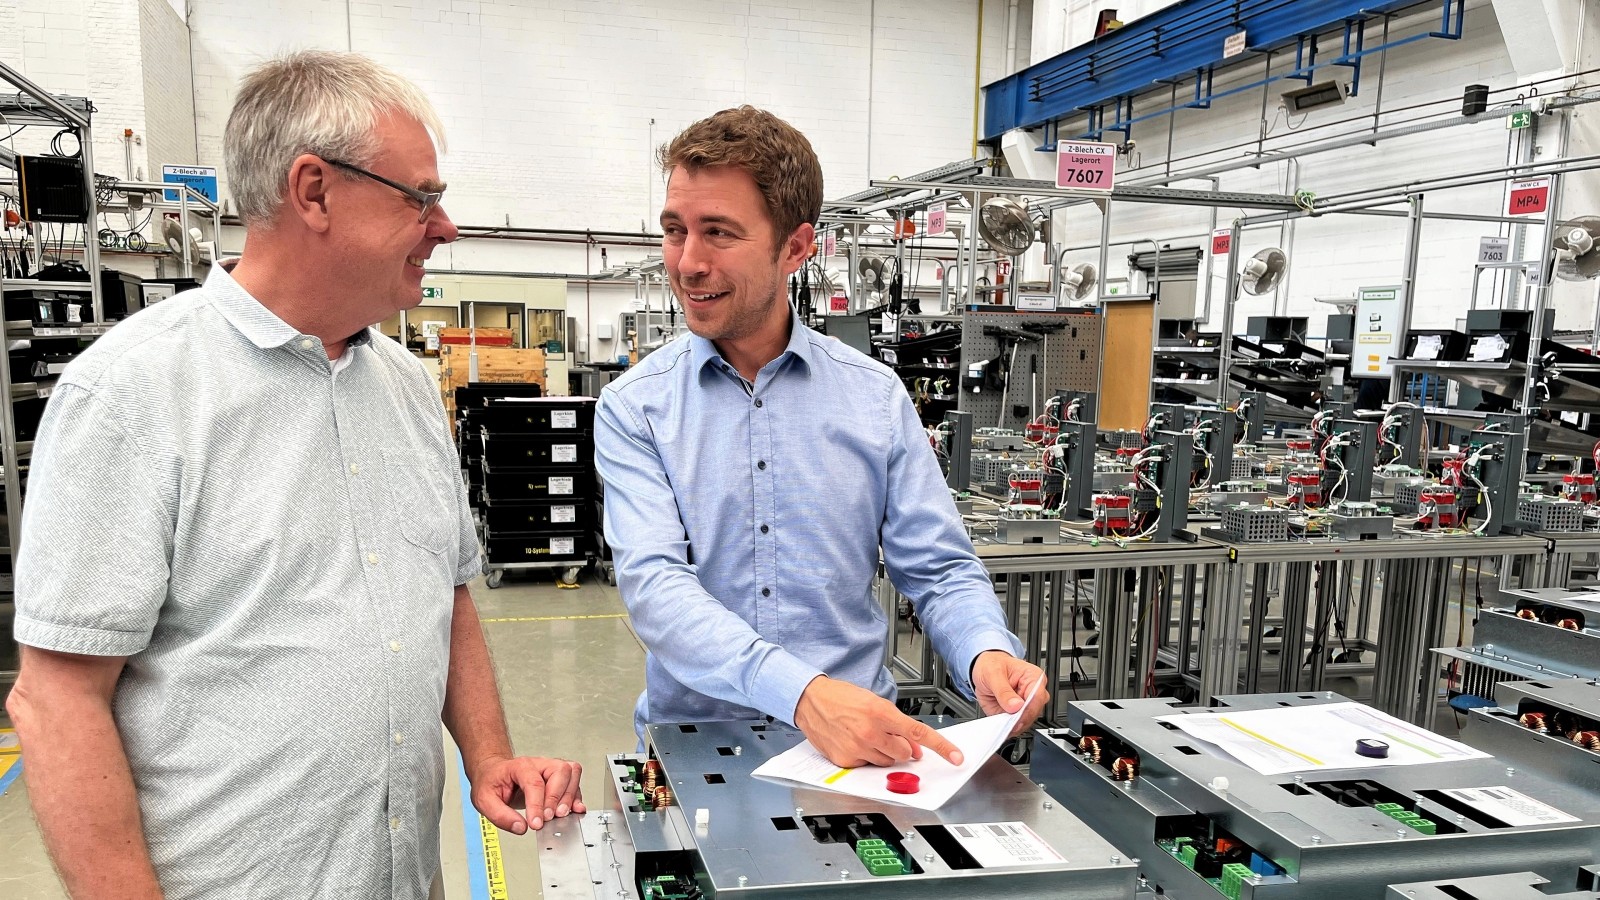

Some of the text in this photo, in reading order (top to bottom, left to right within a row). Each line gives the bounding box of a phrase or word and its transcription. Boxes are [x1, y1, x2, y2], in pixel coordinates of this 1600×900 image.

[1071, 156, 1100, 164] Lagerort
[1067, 168, 1103, 183] 7607
[1517, 194, 1539, 208] MP4
[1216, 240, 1229, 249] MP3
[1483, 252, 1503, 260] 7603
